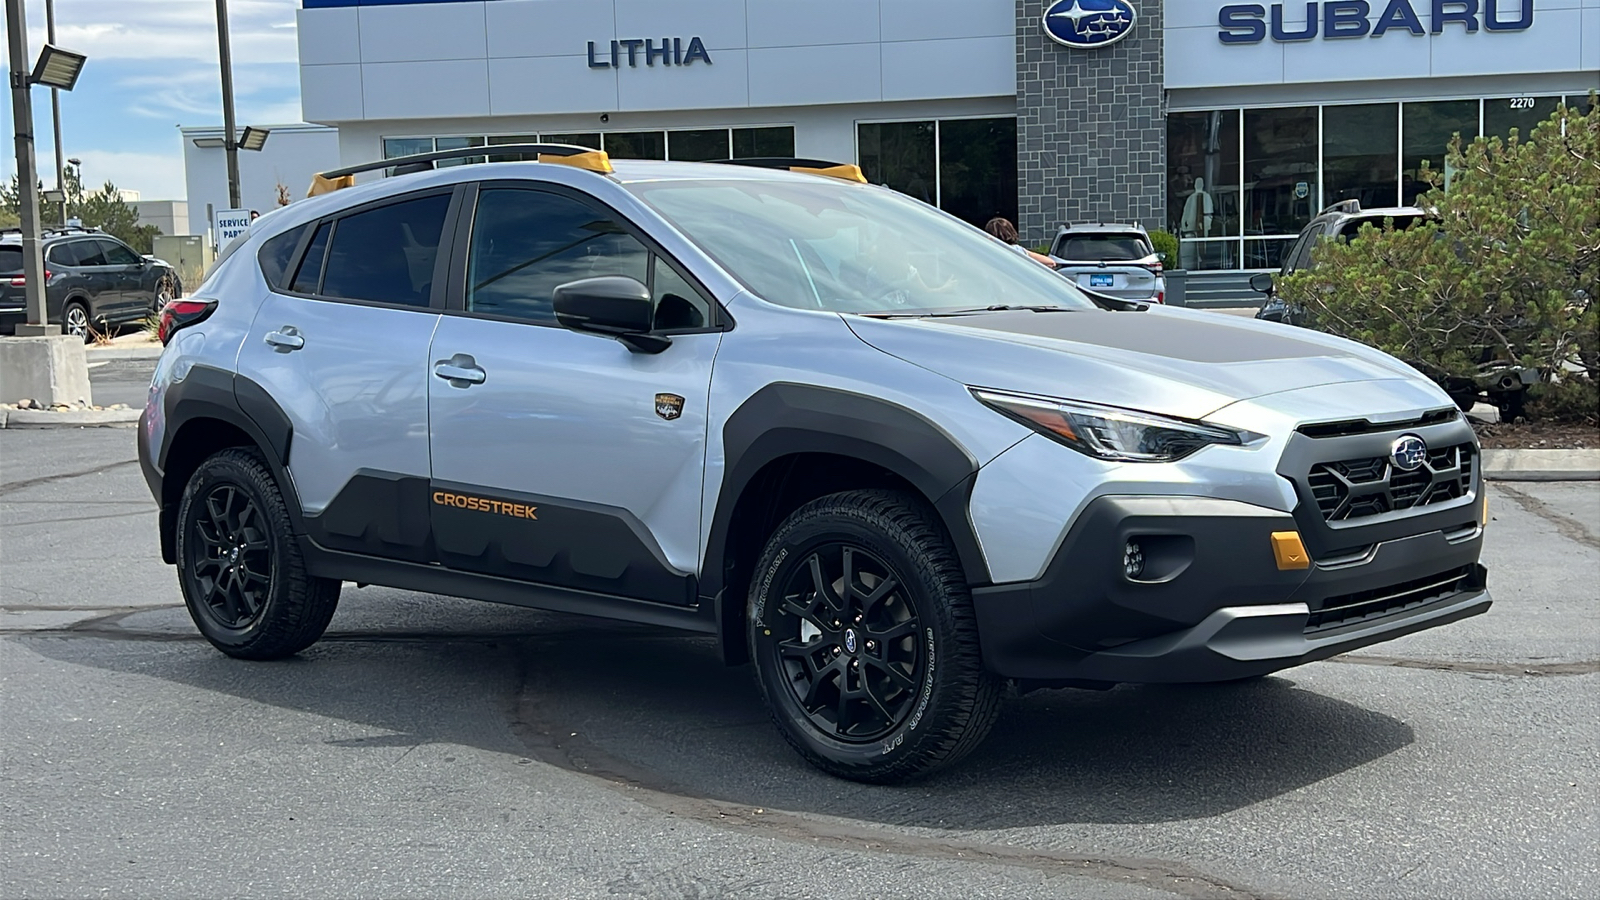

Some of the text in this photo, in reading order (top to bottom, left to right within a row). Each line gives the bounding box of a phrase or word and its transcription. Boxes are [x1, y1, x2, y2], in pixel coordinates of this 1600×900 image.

[1218, 0, 1534, 43] SUBARU
[587, 37, 713, 68] LITHIA
[1510, 98, 1535, 109] 2270
[219, 219, 249, 228] SERVICE
[223, 230, 245, 239] PART
[433, 492, 538, 520] CROSSTREK
[756, 548, 789, 627] YOKOHAMA
